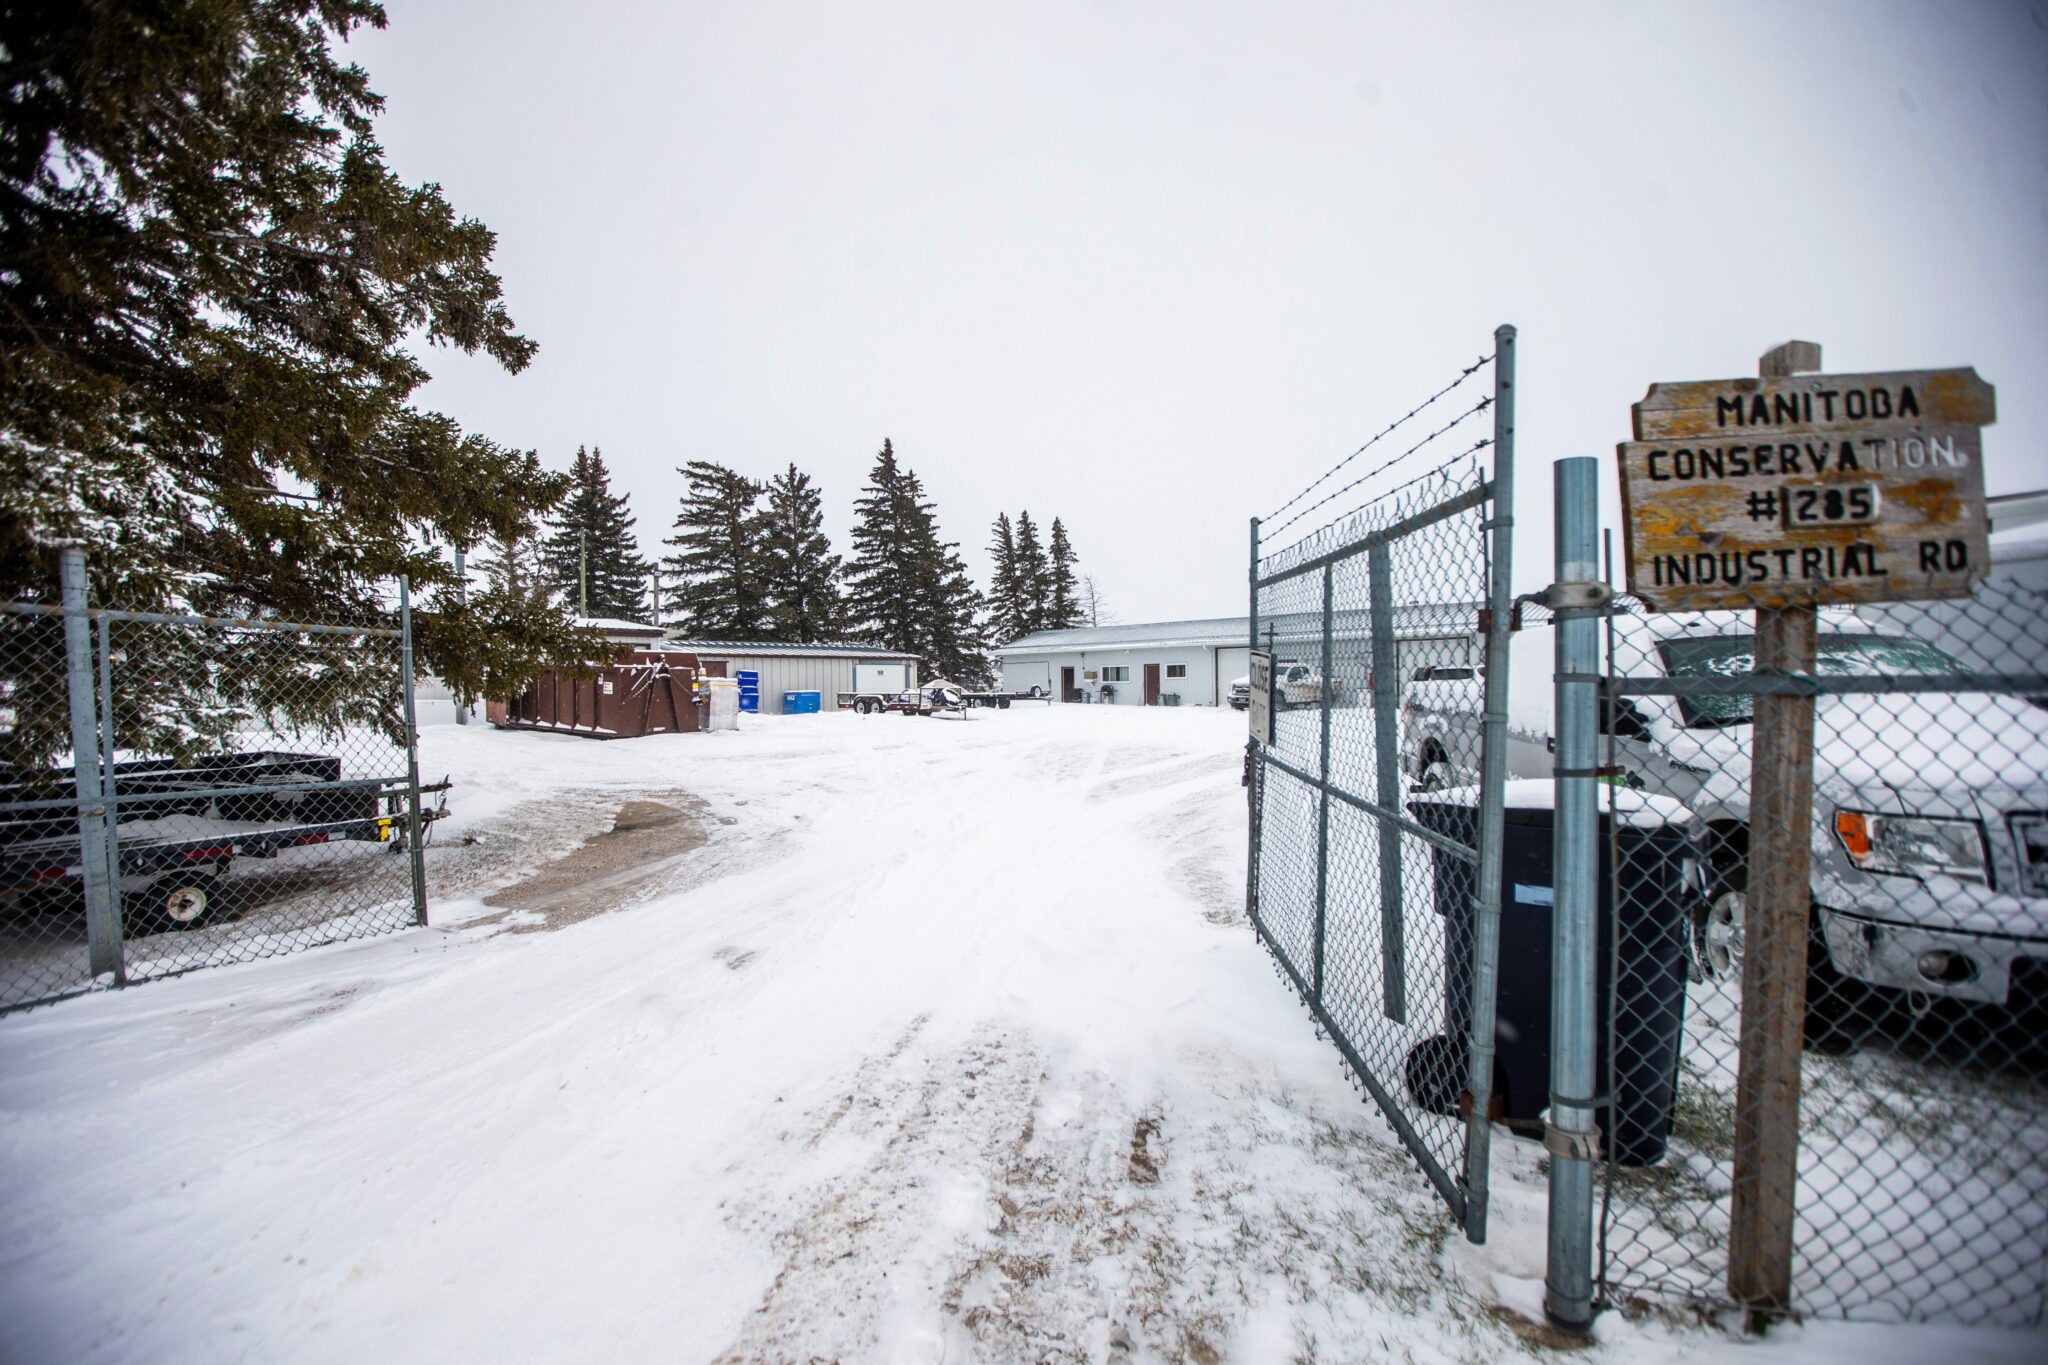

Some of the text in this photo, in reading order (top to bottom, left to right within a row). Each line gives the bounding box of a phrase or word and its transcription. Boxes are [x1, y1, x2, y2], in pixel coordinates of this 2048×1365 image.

[1716, 386, 1920, 427] MANITOBA
[1648, 435, 1962, 481] CONSERVATION
[1653, 539, 1968, 587] INDUSTRIAL RD
